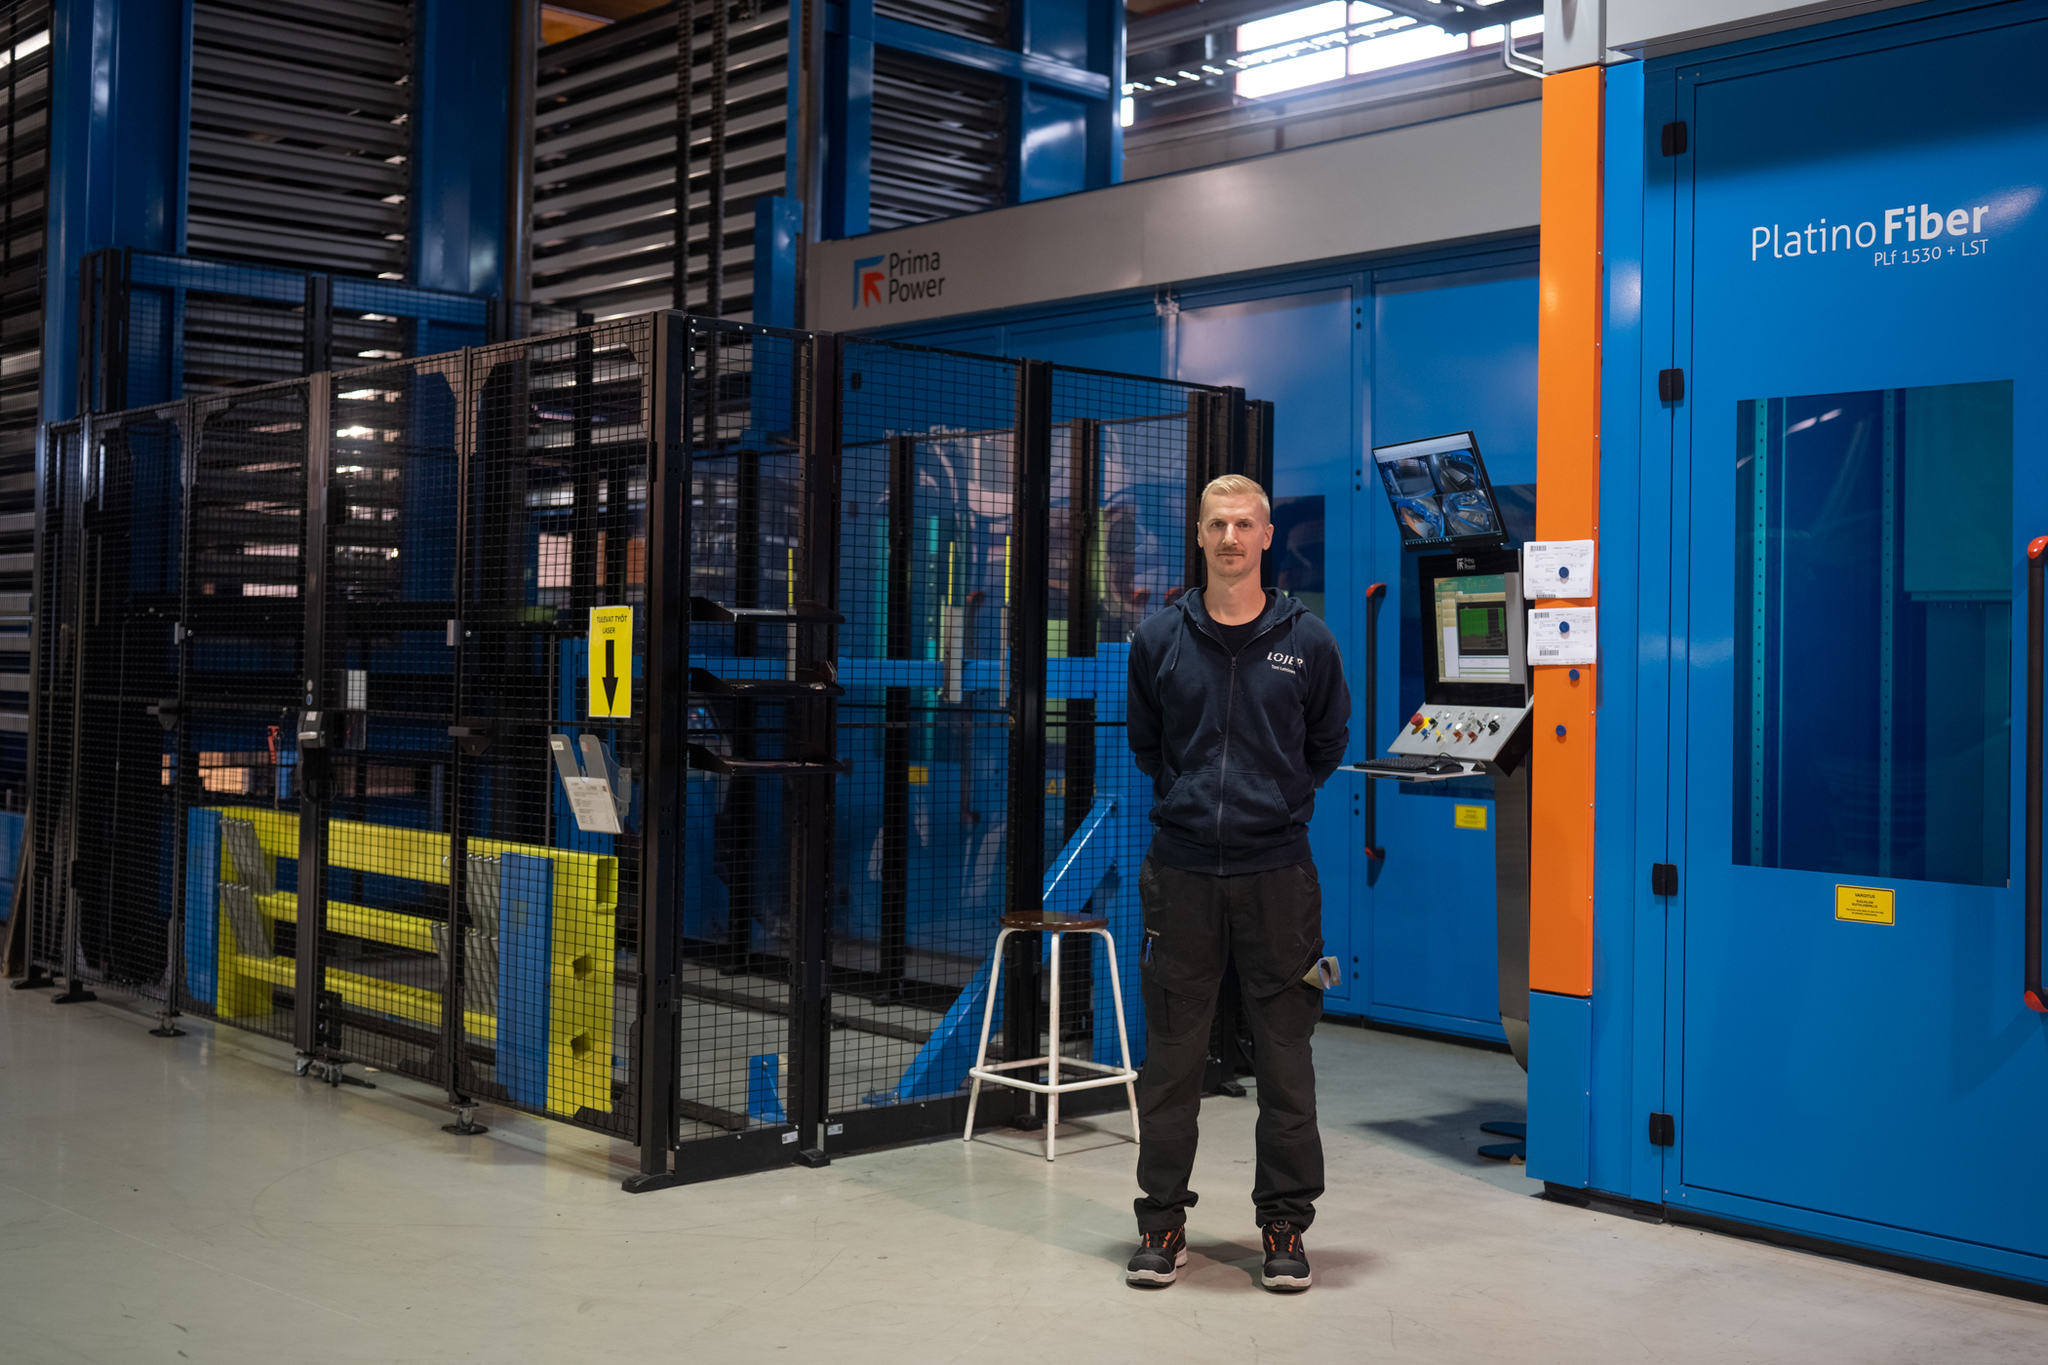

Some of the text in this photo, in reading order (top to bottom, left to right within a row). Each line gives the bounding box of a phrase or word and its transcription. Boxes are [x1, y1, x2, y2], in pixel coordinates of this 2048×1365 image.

[888, 249, 941, 277] Prima
[1901, 246, 1942, 264] 1530
[1962, 239, 1989, 257] LST
[888, 276, 946, 304] Power
[1266, 651, 1304, 669] LOJER
